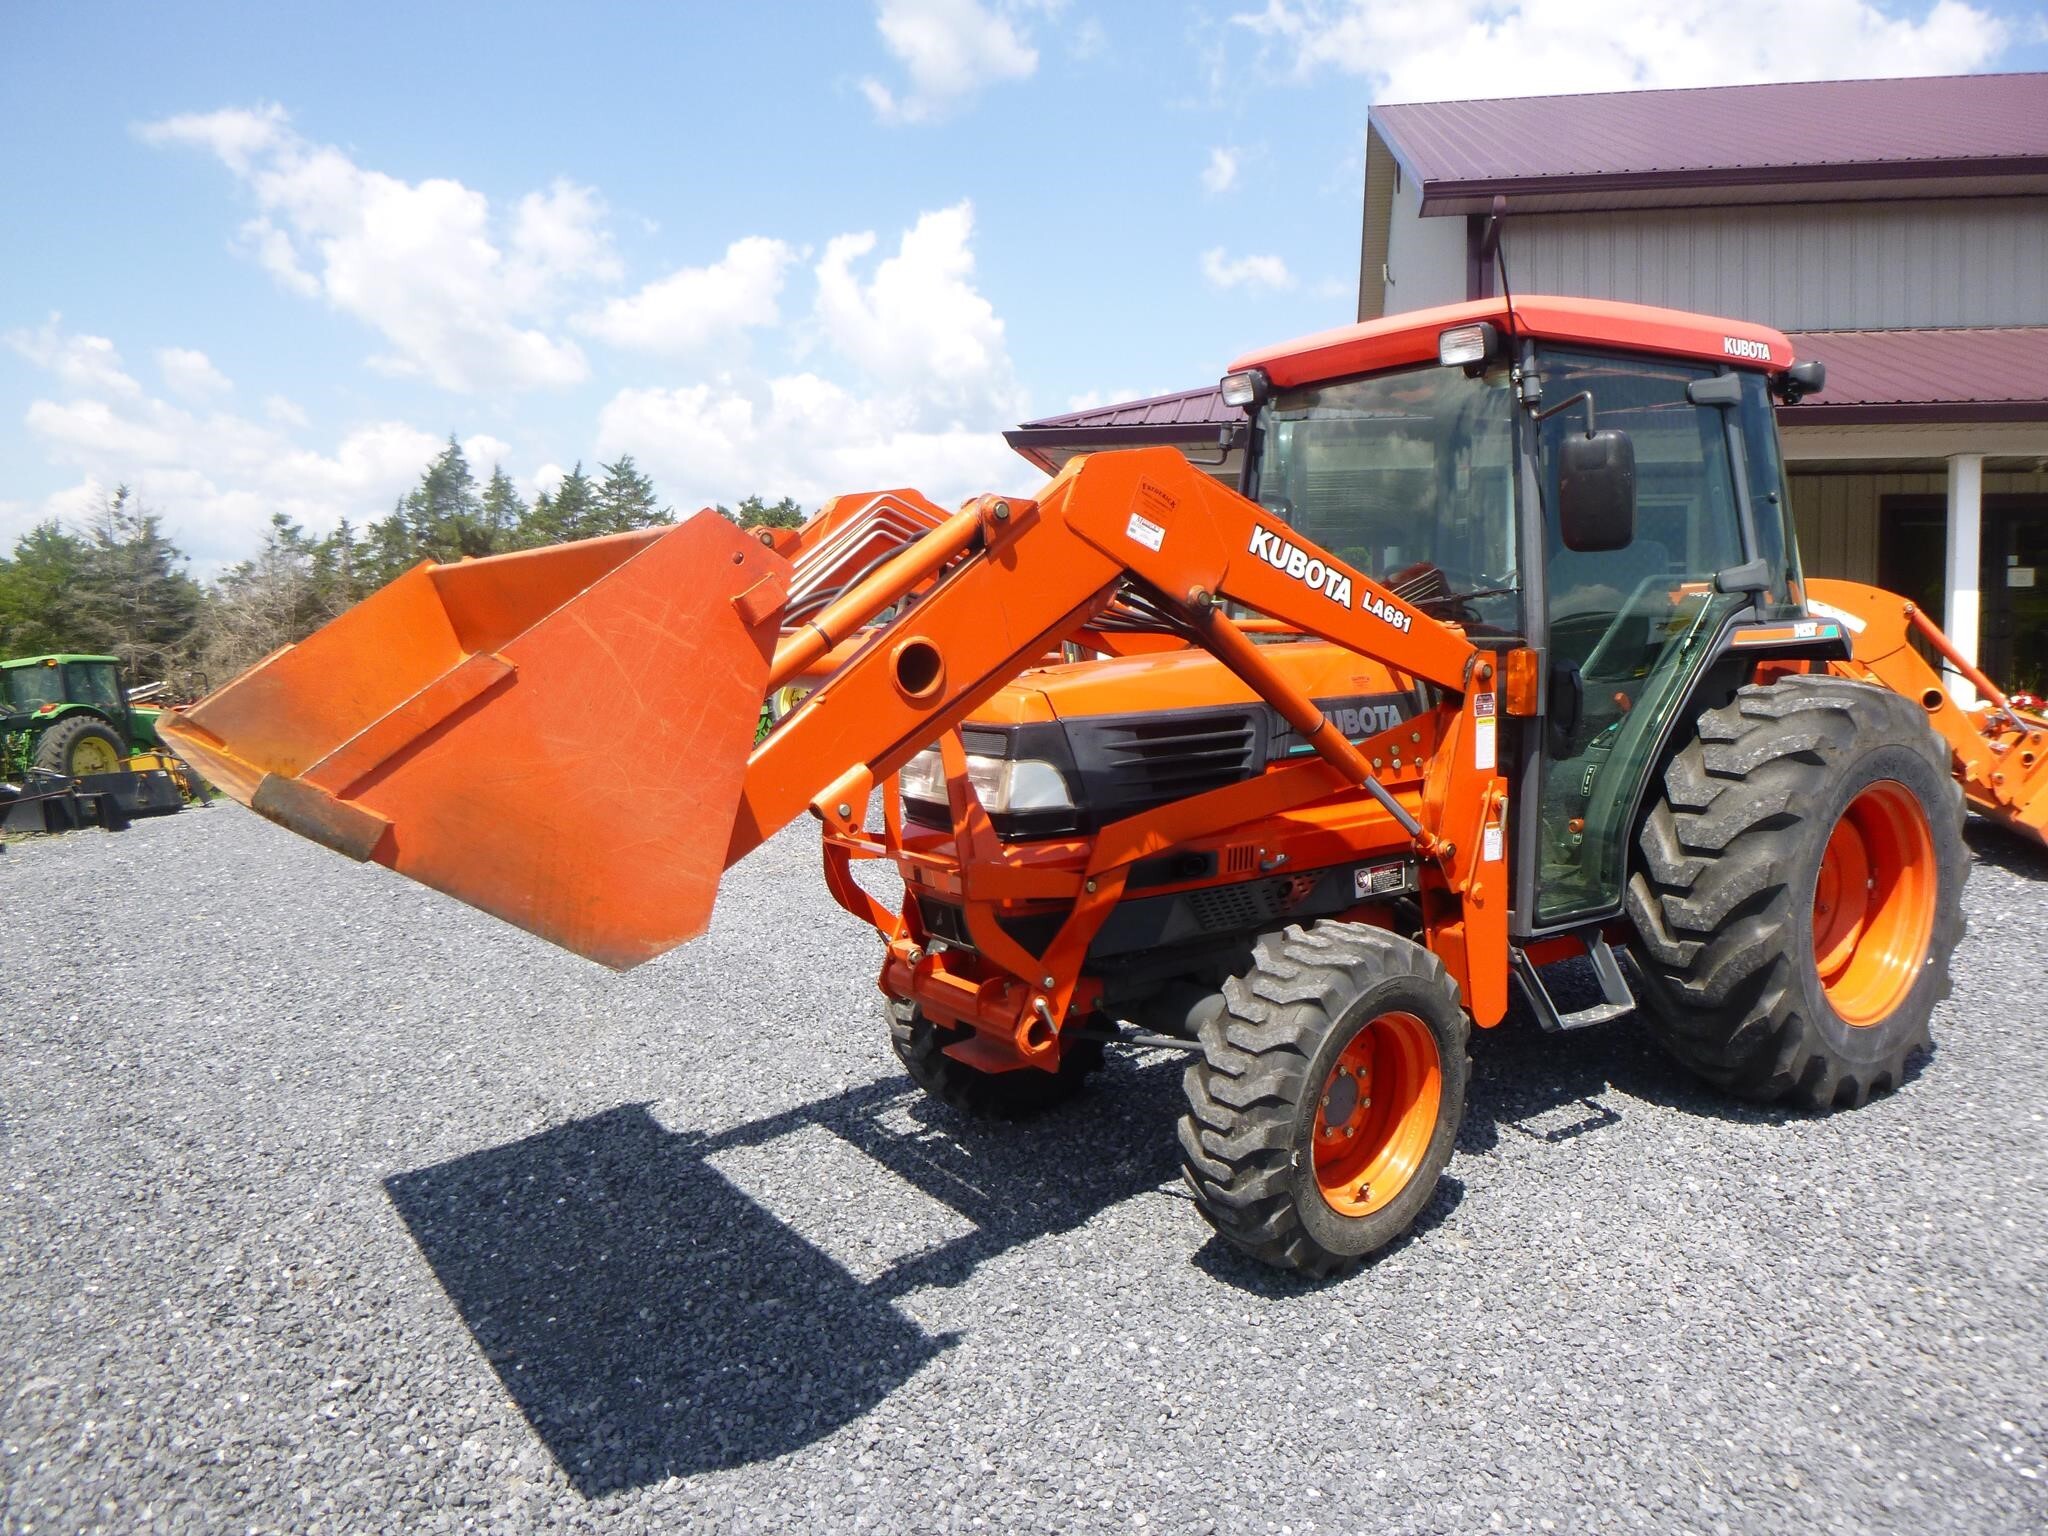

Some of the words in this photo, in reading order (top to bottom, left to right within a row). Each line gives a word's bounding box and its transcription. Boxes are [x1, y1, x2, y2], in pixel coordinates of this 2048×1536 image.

[1723, 336, 1771, 360] KUBOTA
[1249, 524, 1352, 609] KUBOTA
[1362, 590, 1412, 633] LA681
[1322, 704, 1403, 735] UBOTA
